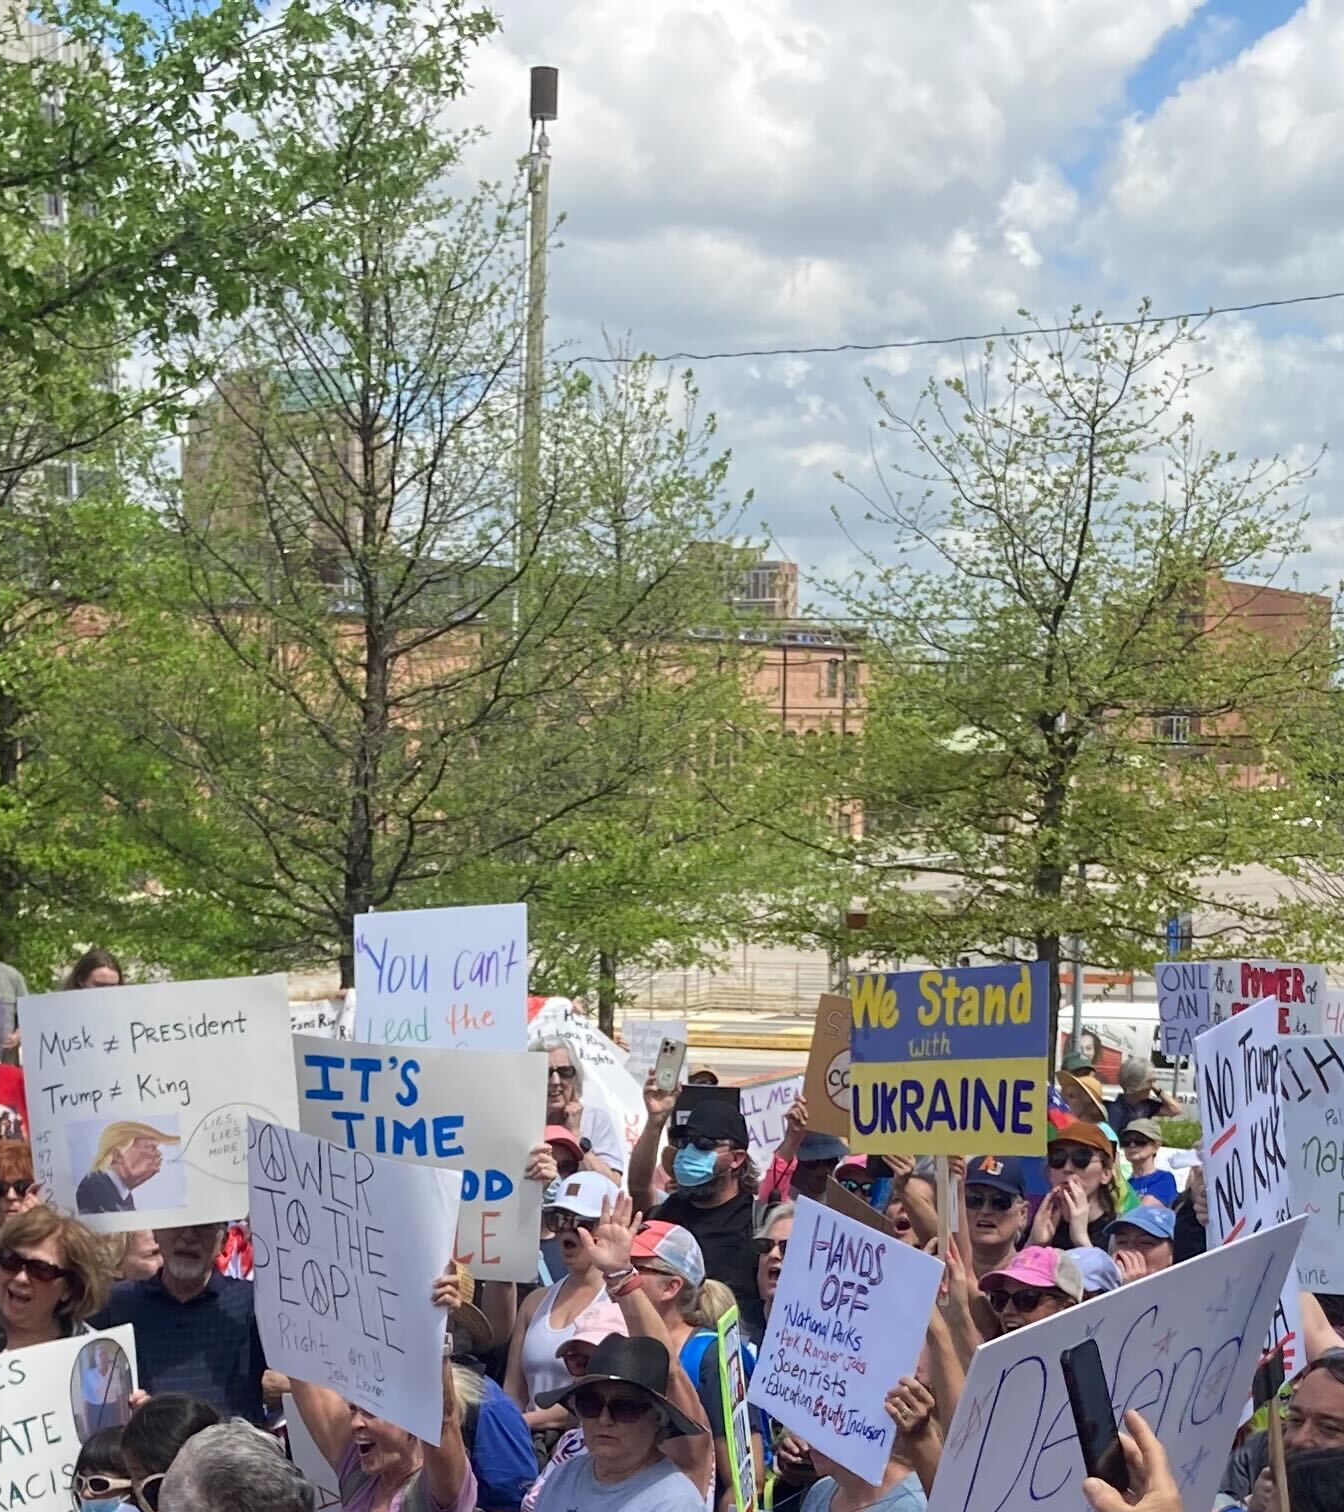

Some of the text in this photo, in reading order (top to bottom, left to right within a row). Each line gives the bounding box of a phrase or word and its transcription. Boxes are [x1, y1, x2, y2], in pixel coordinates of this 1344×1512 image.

[452, 938, 522, 992] can't
[1160, 965, 1210, 992] ONL
[1212, 966, 1235, 996] the
[444, 1000, 497, 1031] the
[849, 965, 1033, 1029] We Stand
[39, 1026, 95, 1070] Musk
[908, 1031, 952, 1058] with
[42, 1074, 192, 1114] Trump King
[304, 1054, 422, 1108] IT'S
[852, 1077, 1035, 1136] UKRAINE
[1205, 1028, 1279, 1134] NO Trump
[331, 1110, 464, 1158] TIME
[1215, 1147, 1245, 1240] NO
[1250, 1105, 1288, 1202] KKK
[322, 1206, 388, 1277] THE
[809, 1214, 887, 1286] HANDS
[820, 1273, 871, 1322] OFF
